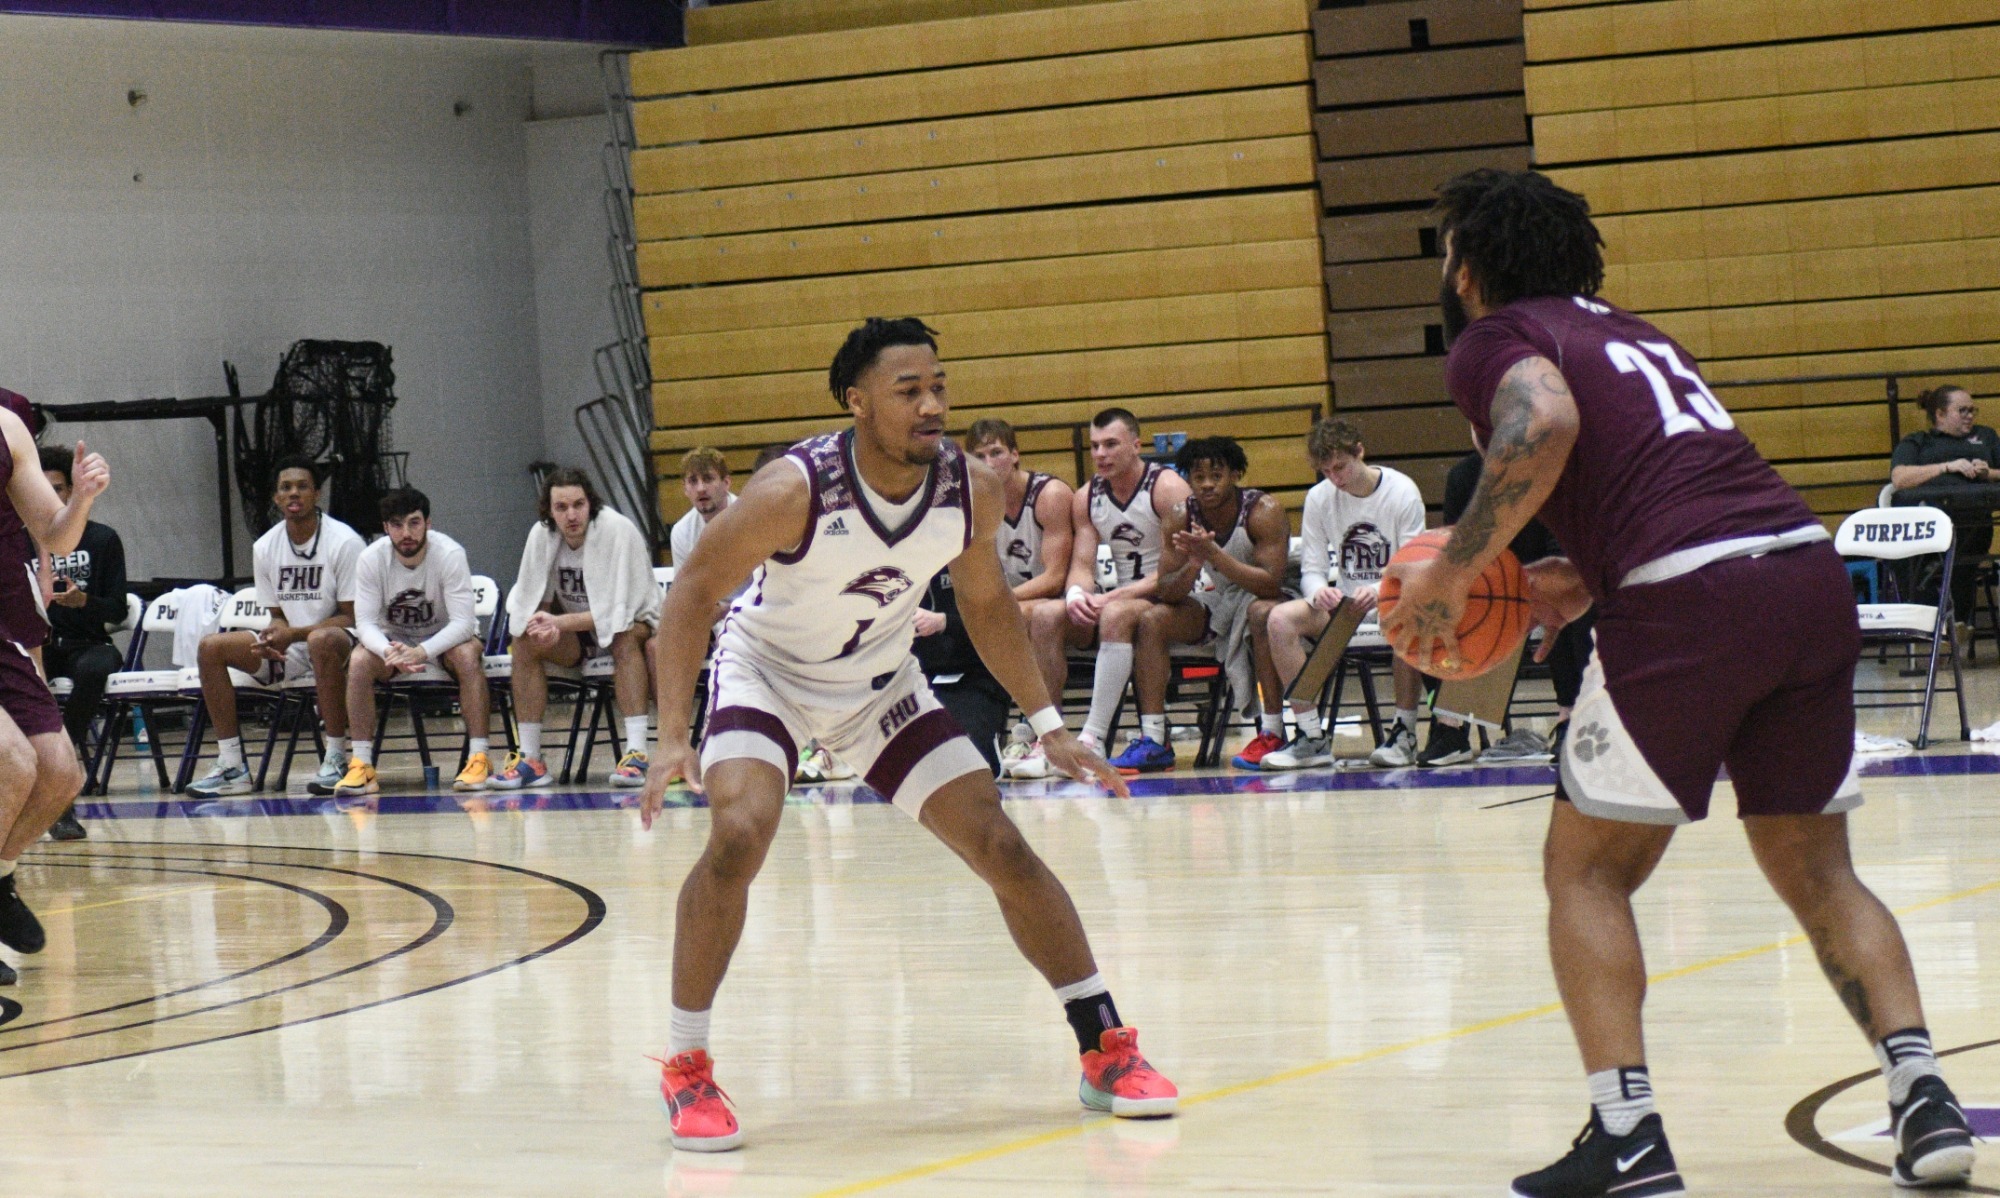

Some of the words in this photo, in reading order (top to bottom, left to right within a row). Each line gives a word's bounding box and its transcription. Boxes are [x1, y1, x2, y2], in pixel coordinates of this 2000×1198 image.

[1605, 340, 1735, 437] 23
[823, 528, 849, 536] adidas
[1853, 521, 1936, 542] PURPLES
[1341, 541, 1391, 570] FHU
[277, 564, 324, 592] FHU
[559, 567, 586, 593] FH
[878, 692, 920, 740] FHU
